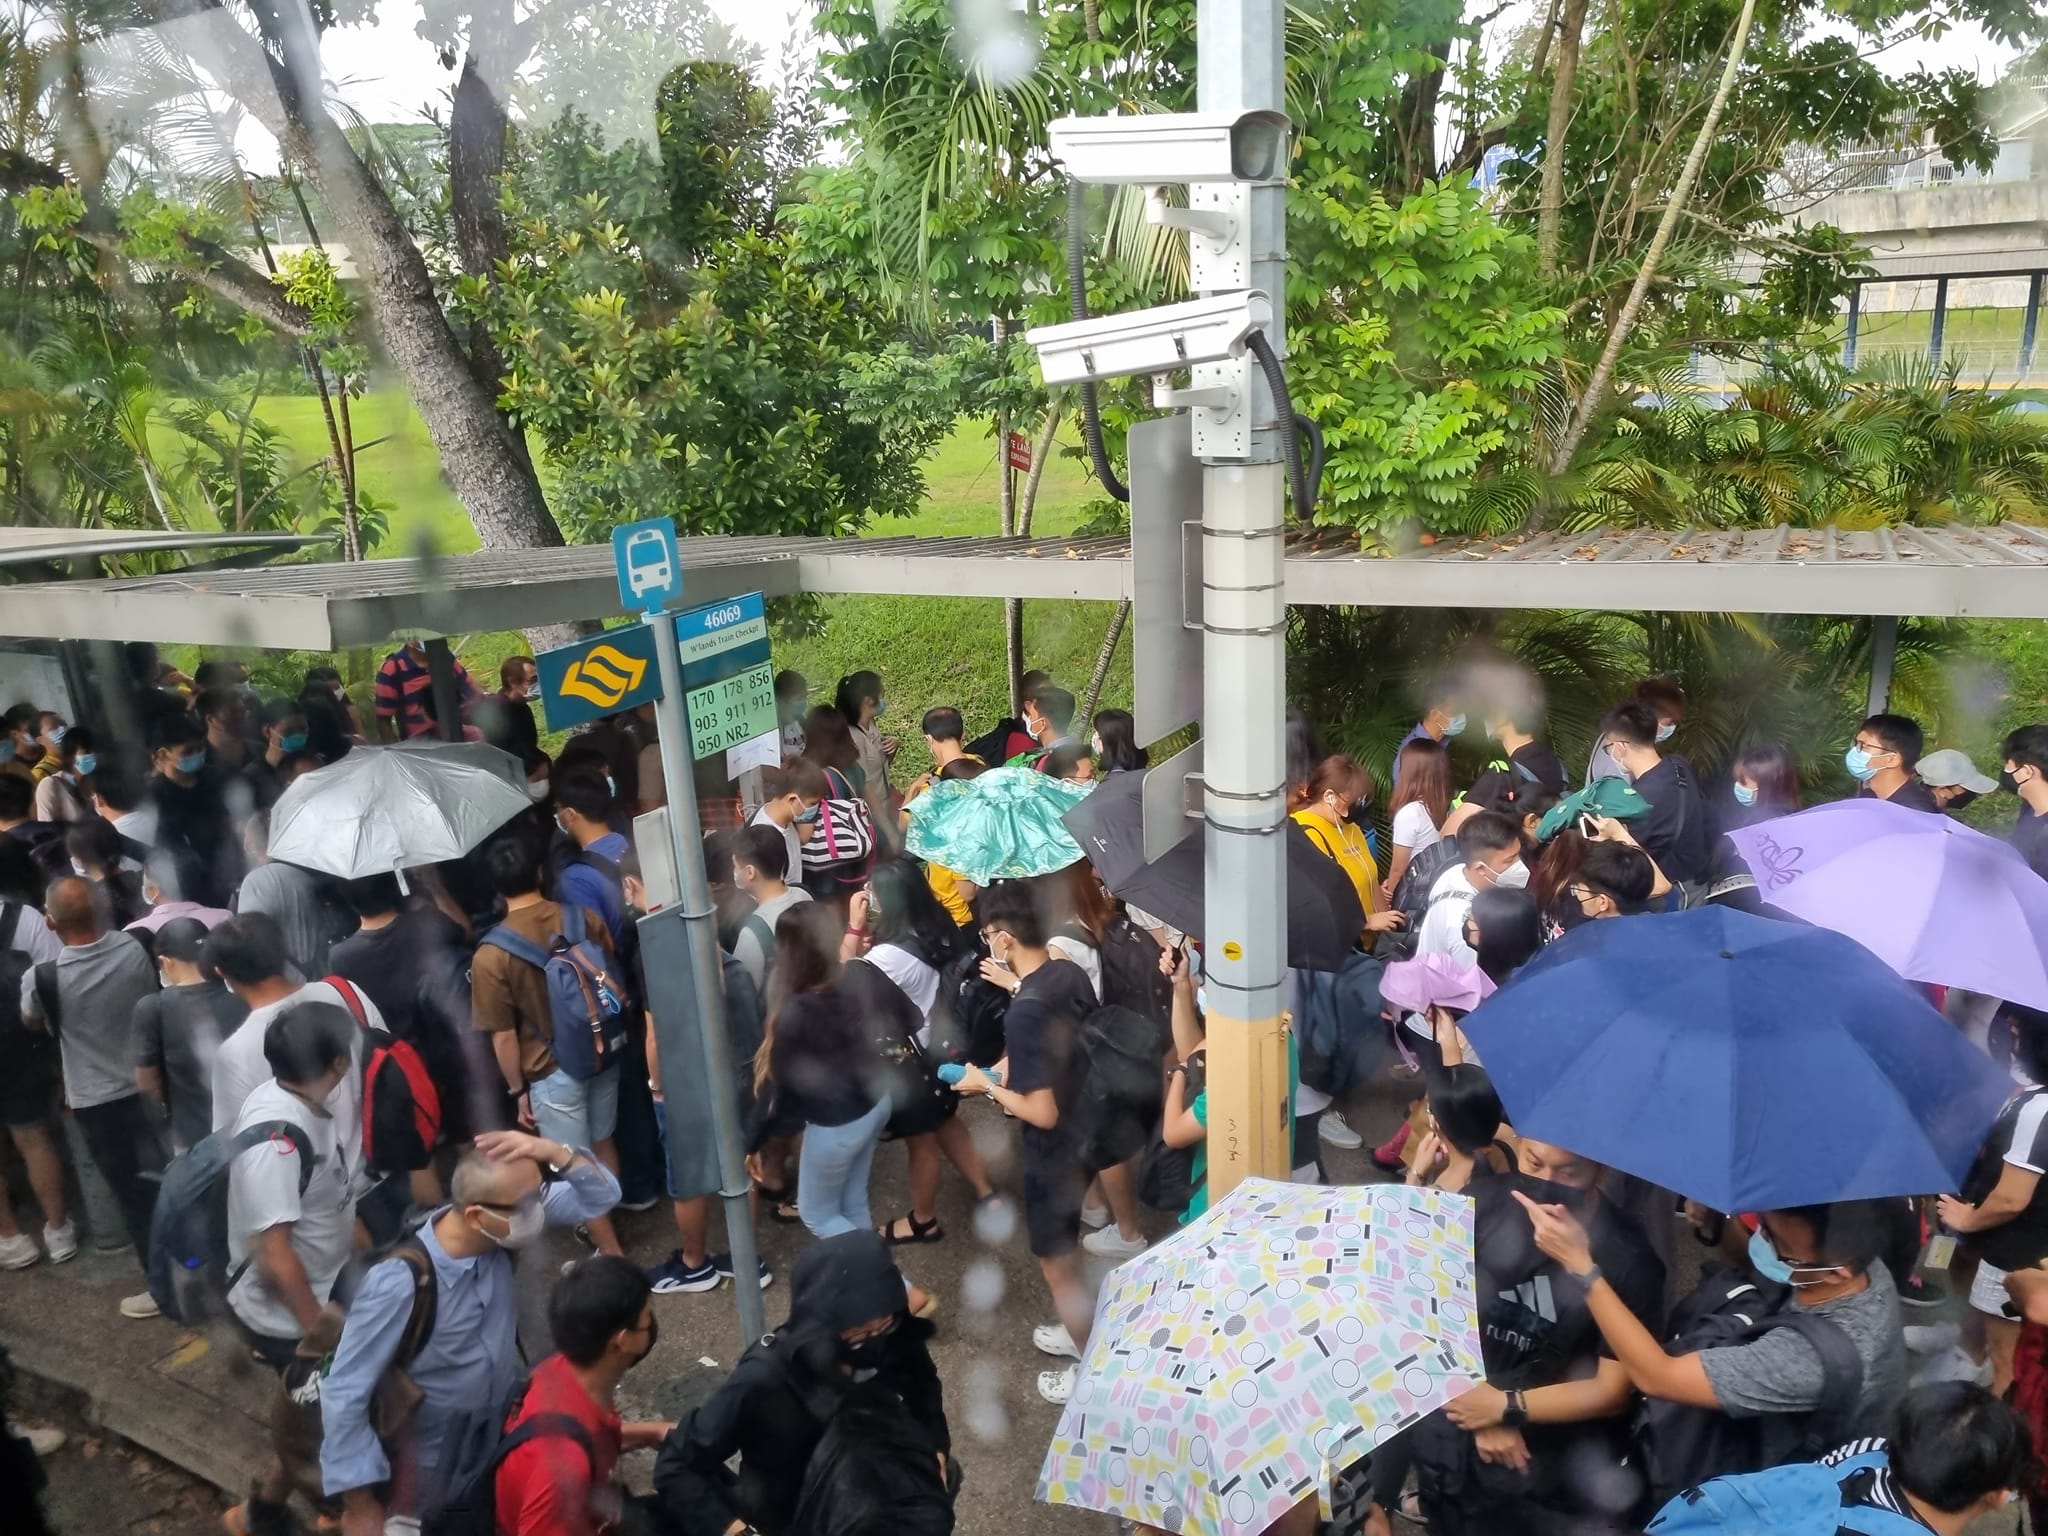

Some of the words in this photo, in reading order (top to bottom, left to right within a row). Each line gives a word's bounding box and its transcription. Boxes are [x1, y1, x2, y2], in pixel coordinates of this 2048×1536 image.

[704, 605, 741, 629] 46069
[718, 633, 734, 645] Train
[735, 624, 759, 639] Checkpt
[692, 690, 715, 710] 170
[723, 680, 743, 699] 178
[749, 670, 770, 689] 856
[695, 713, 718, 733] 903
[725, 702, 746, 722] 911
[752, 691, 772, 711] 912
[698, 734, 721, 755] 950
[726, 722, 750, 744] NR2
